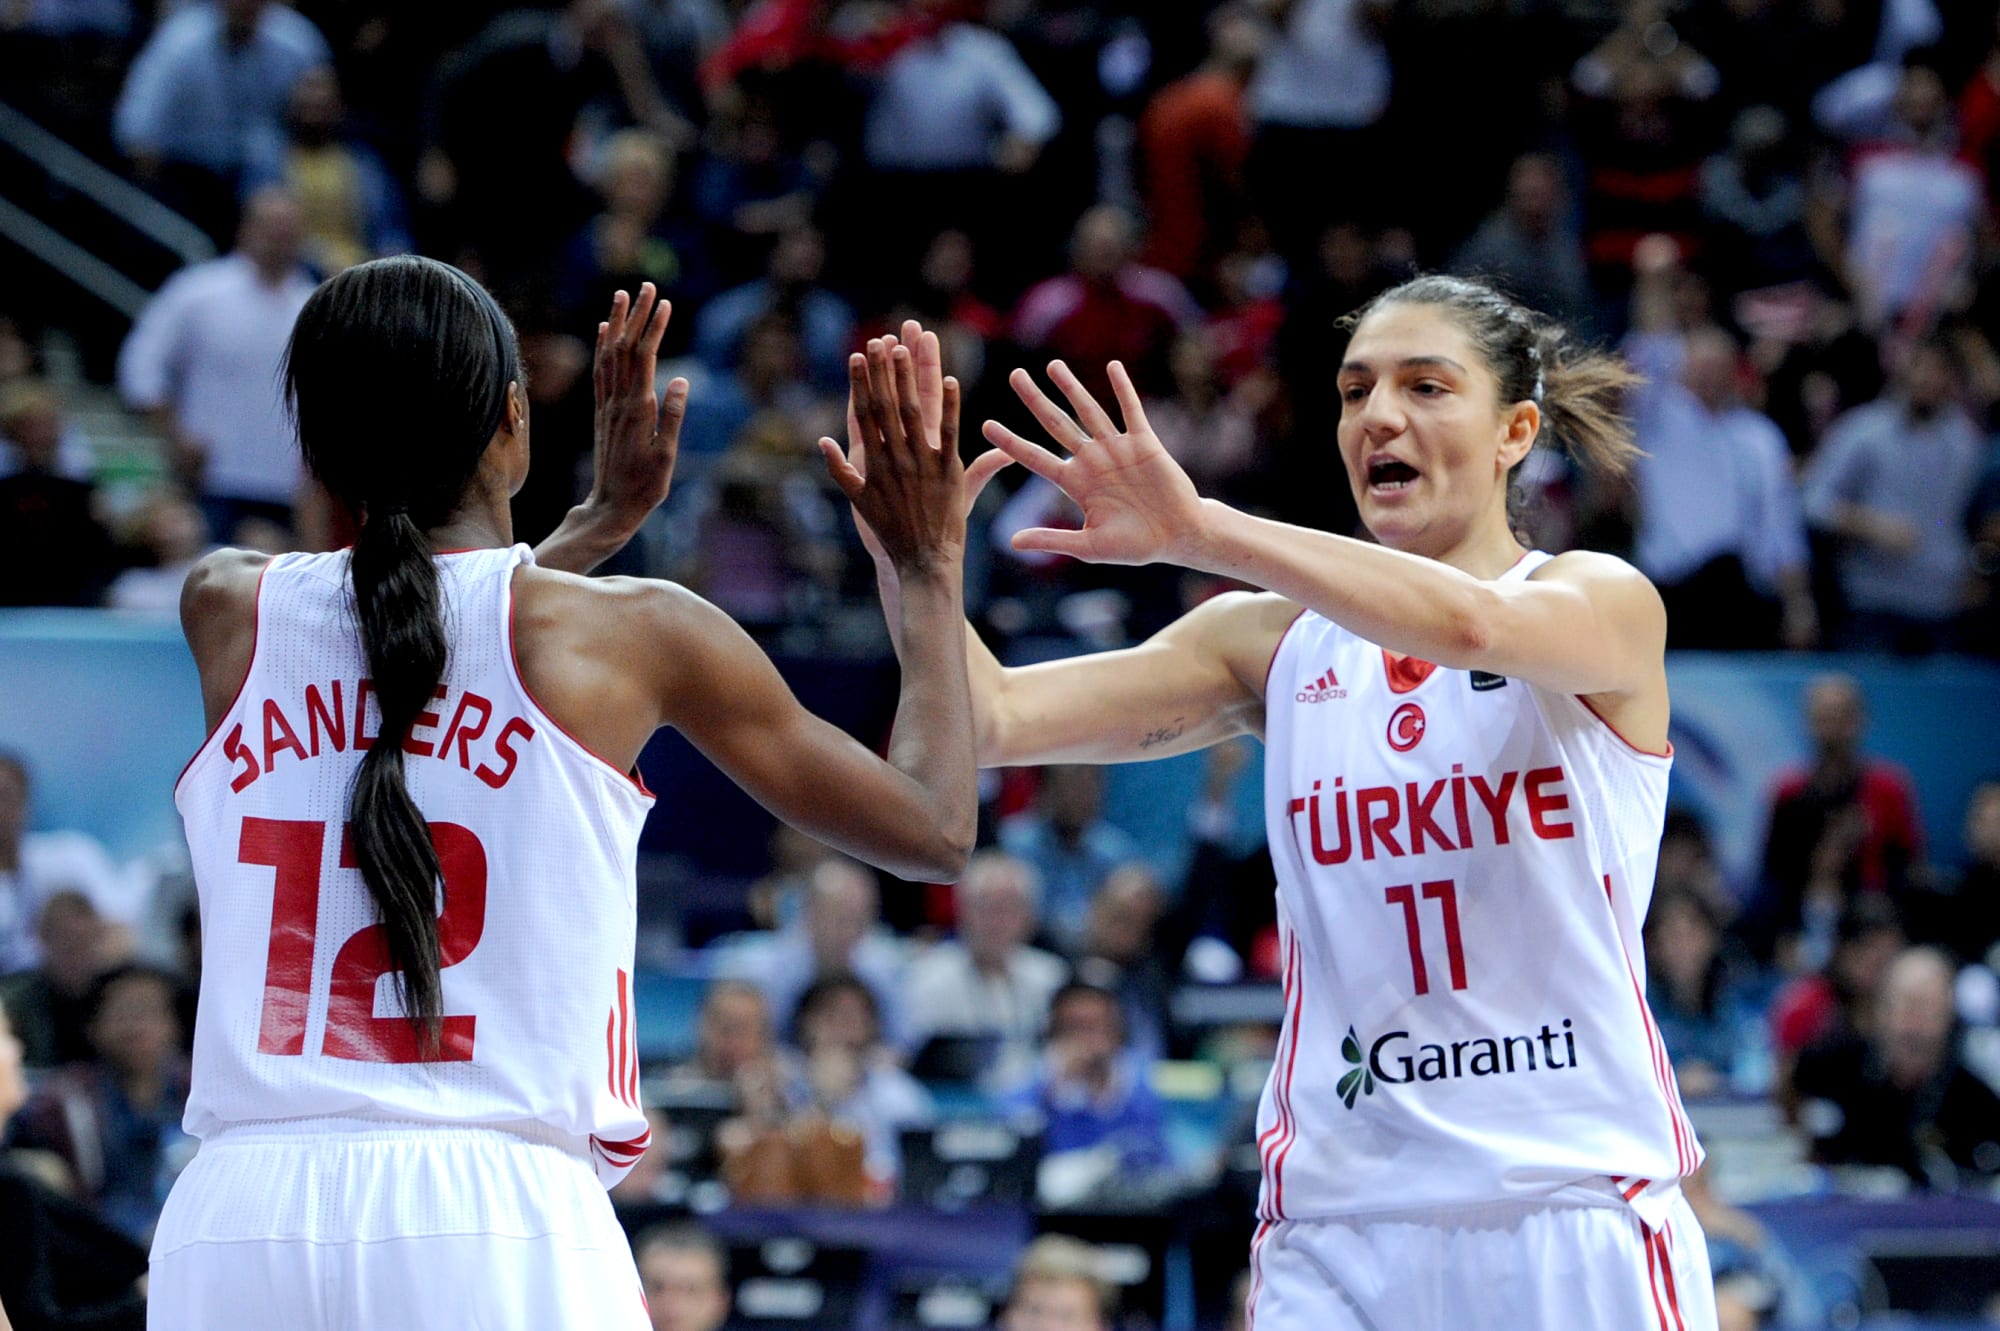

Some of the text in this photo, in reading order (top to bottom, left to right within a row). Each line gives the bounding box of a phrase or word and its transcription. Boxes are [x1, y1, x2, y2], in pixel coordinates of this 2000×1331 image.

[1295, 689, 1347, 704] adidas
[238, 816, 488, 1064] 12
[1385, 879, 1468, 996] 11
[1369, 1018, 1578, 1084] Garanti
